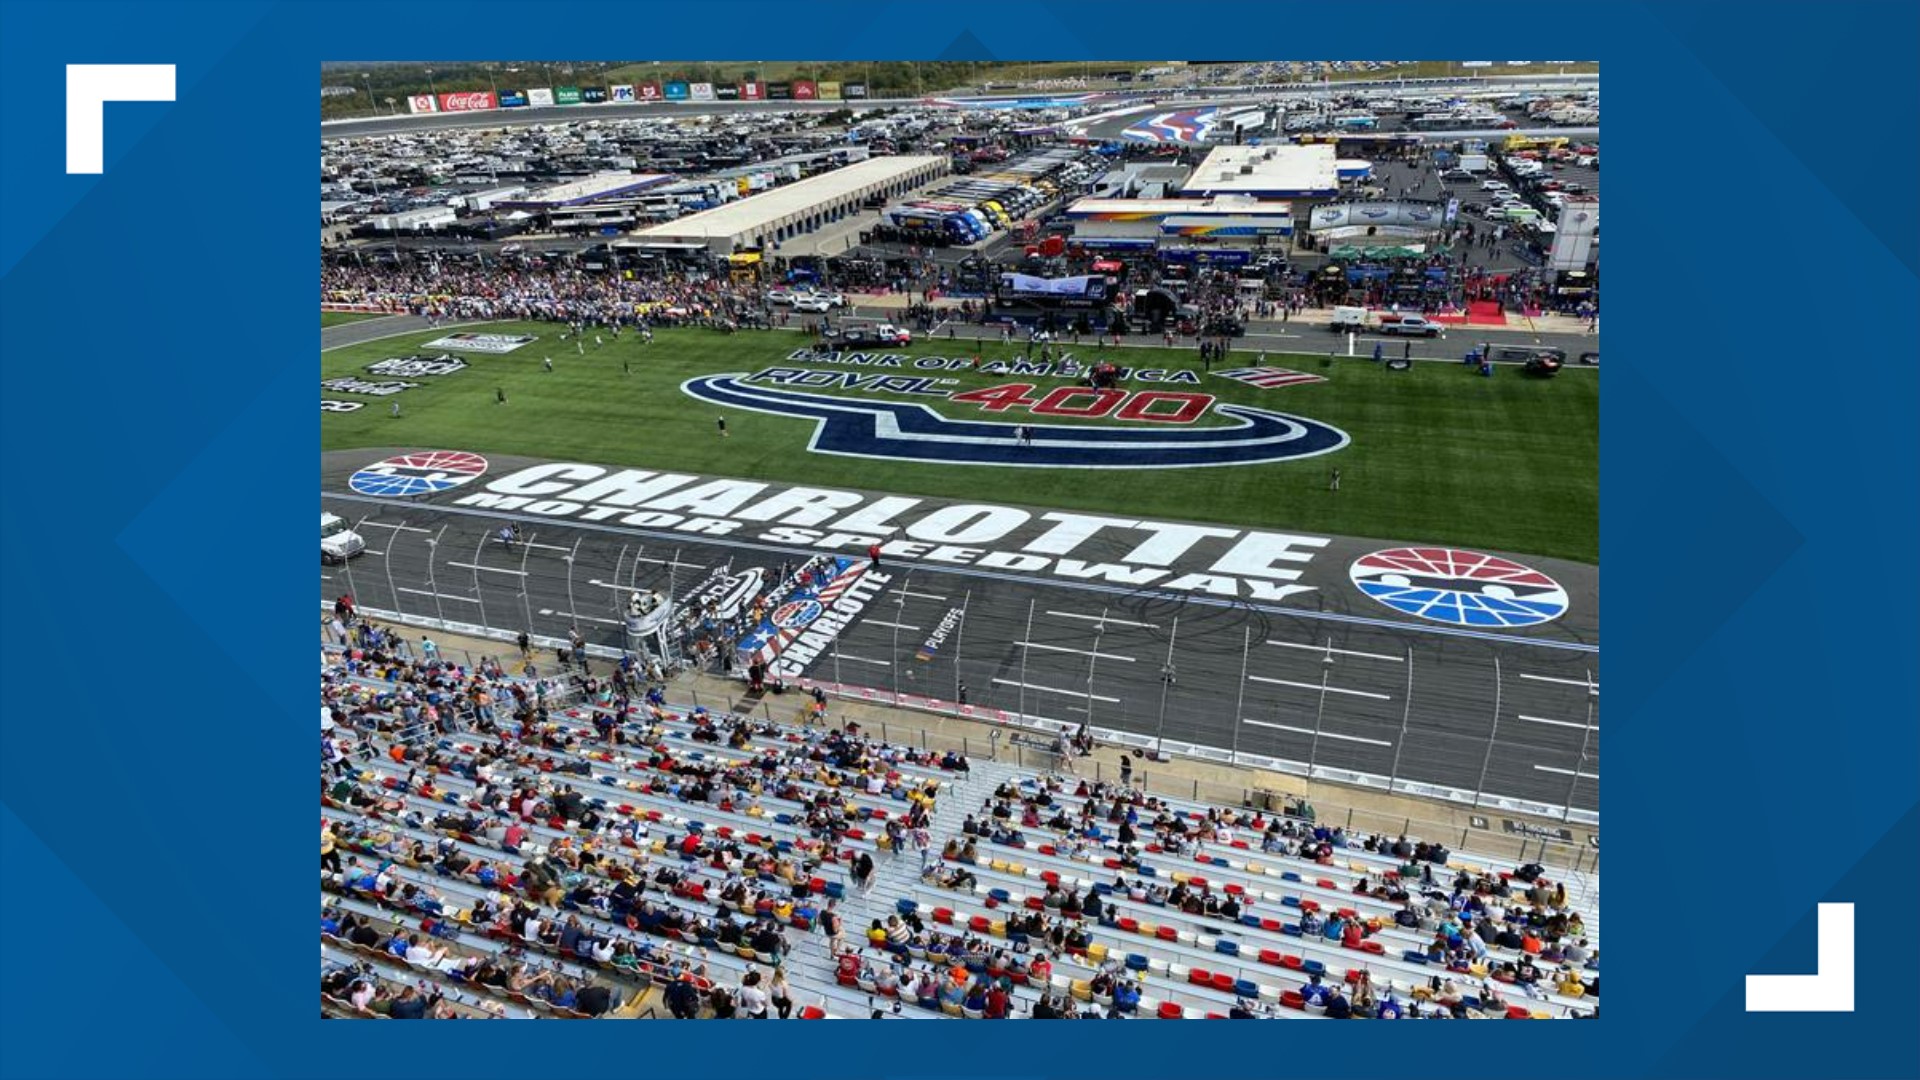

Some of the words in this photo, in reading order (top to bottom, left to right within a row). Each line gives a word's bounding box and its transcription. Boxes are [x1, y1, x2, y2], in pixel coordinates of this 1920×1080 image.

[951, 383, 1216, 423] 400
[452, 493, 743, 535] MOTOR
[758, 526, 1319, 600] SPEEDWAY
[485, 463, 1331, 581] CHARLOTTE
[768, 569, 892, 677] CHARLOTTE
[925, 608, 964, 649] PLAYOFFS
